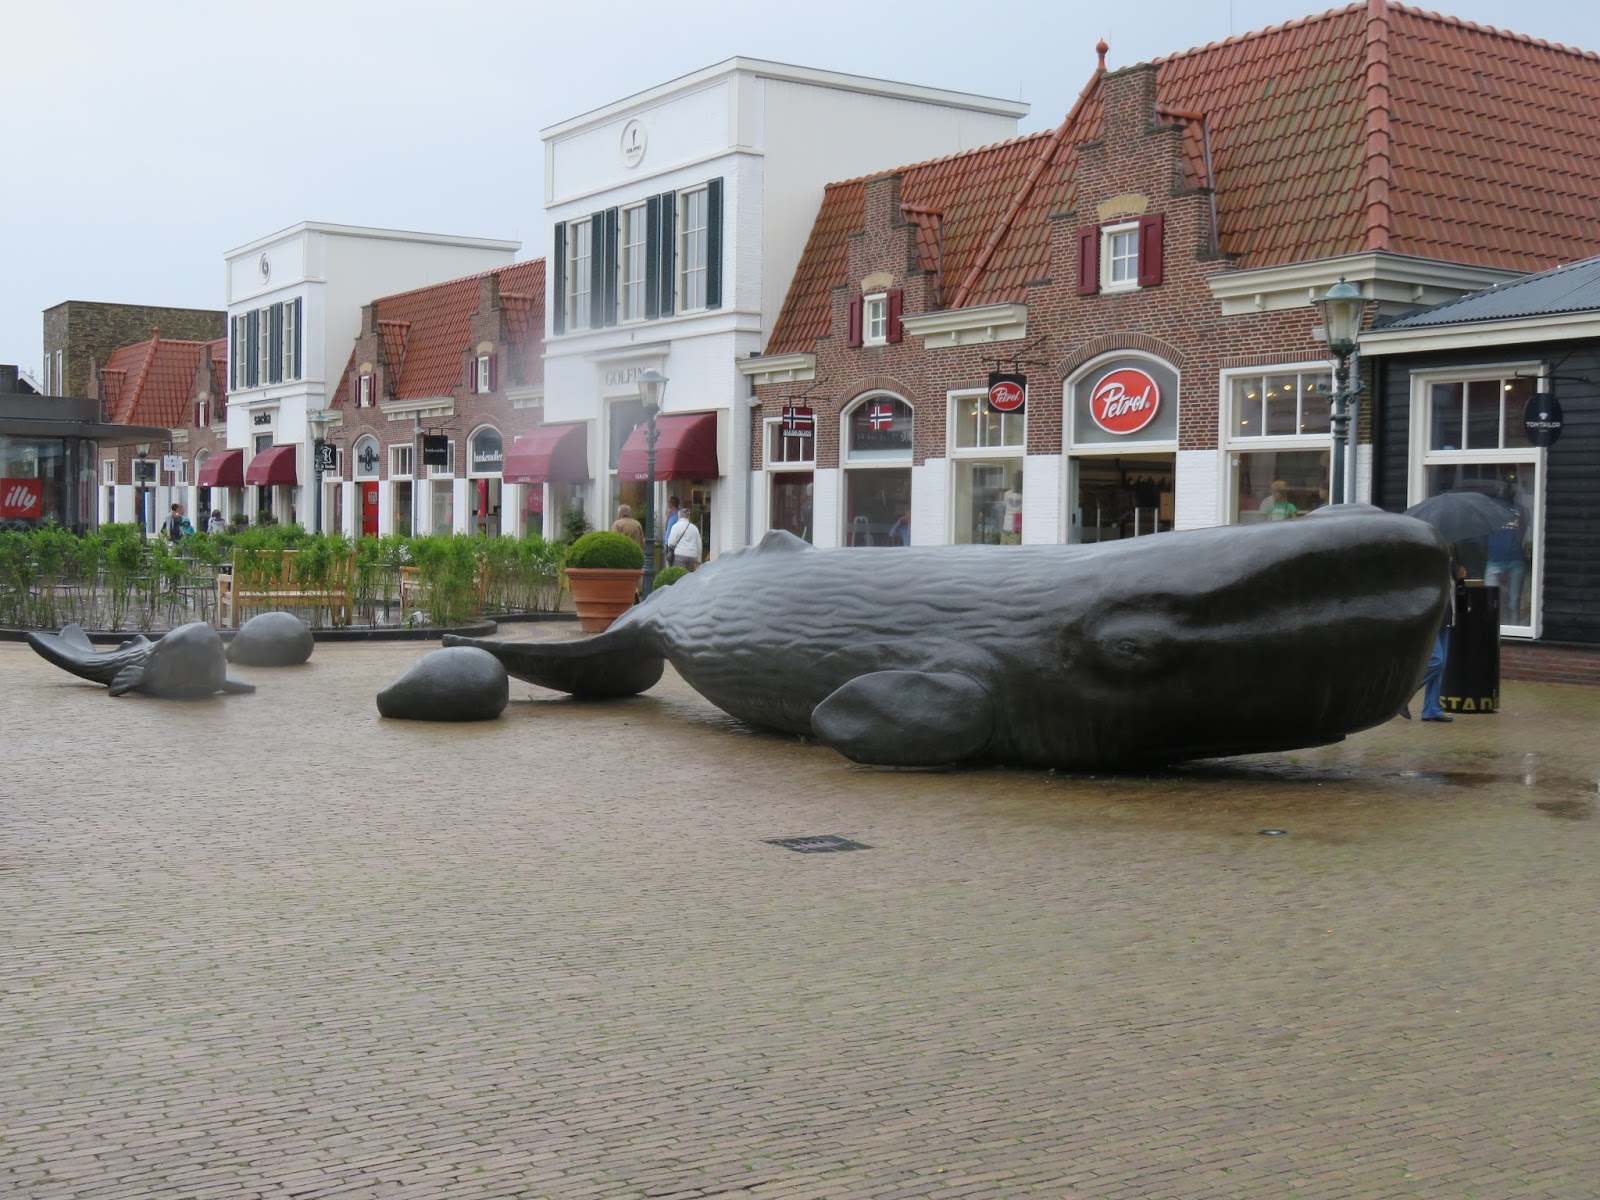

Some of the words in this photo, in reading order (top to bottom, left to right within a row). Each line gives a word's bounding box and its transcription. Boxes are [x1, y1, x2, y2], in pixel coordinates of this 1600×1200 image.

[605, 366, 652, 385] GOLFIN
[991, 387, 1020, 404] Petrol
[1095, 383, 1152, 420] Petrol
[5, 486, 37, 512] illy
